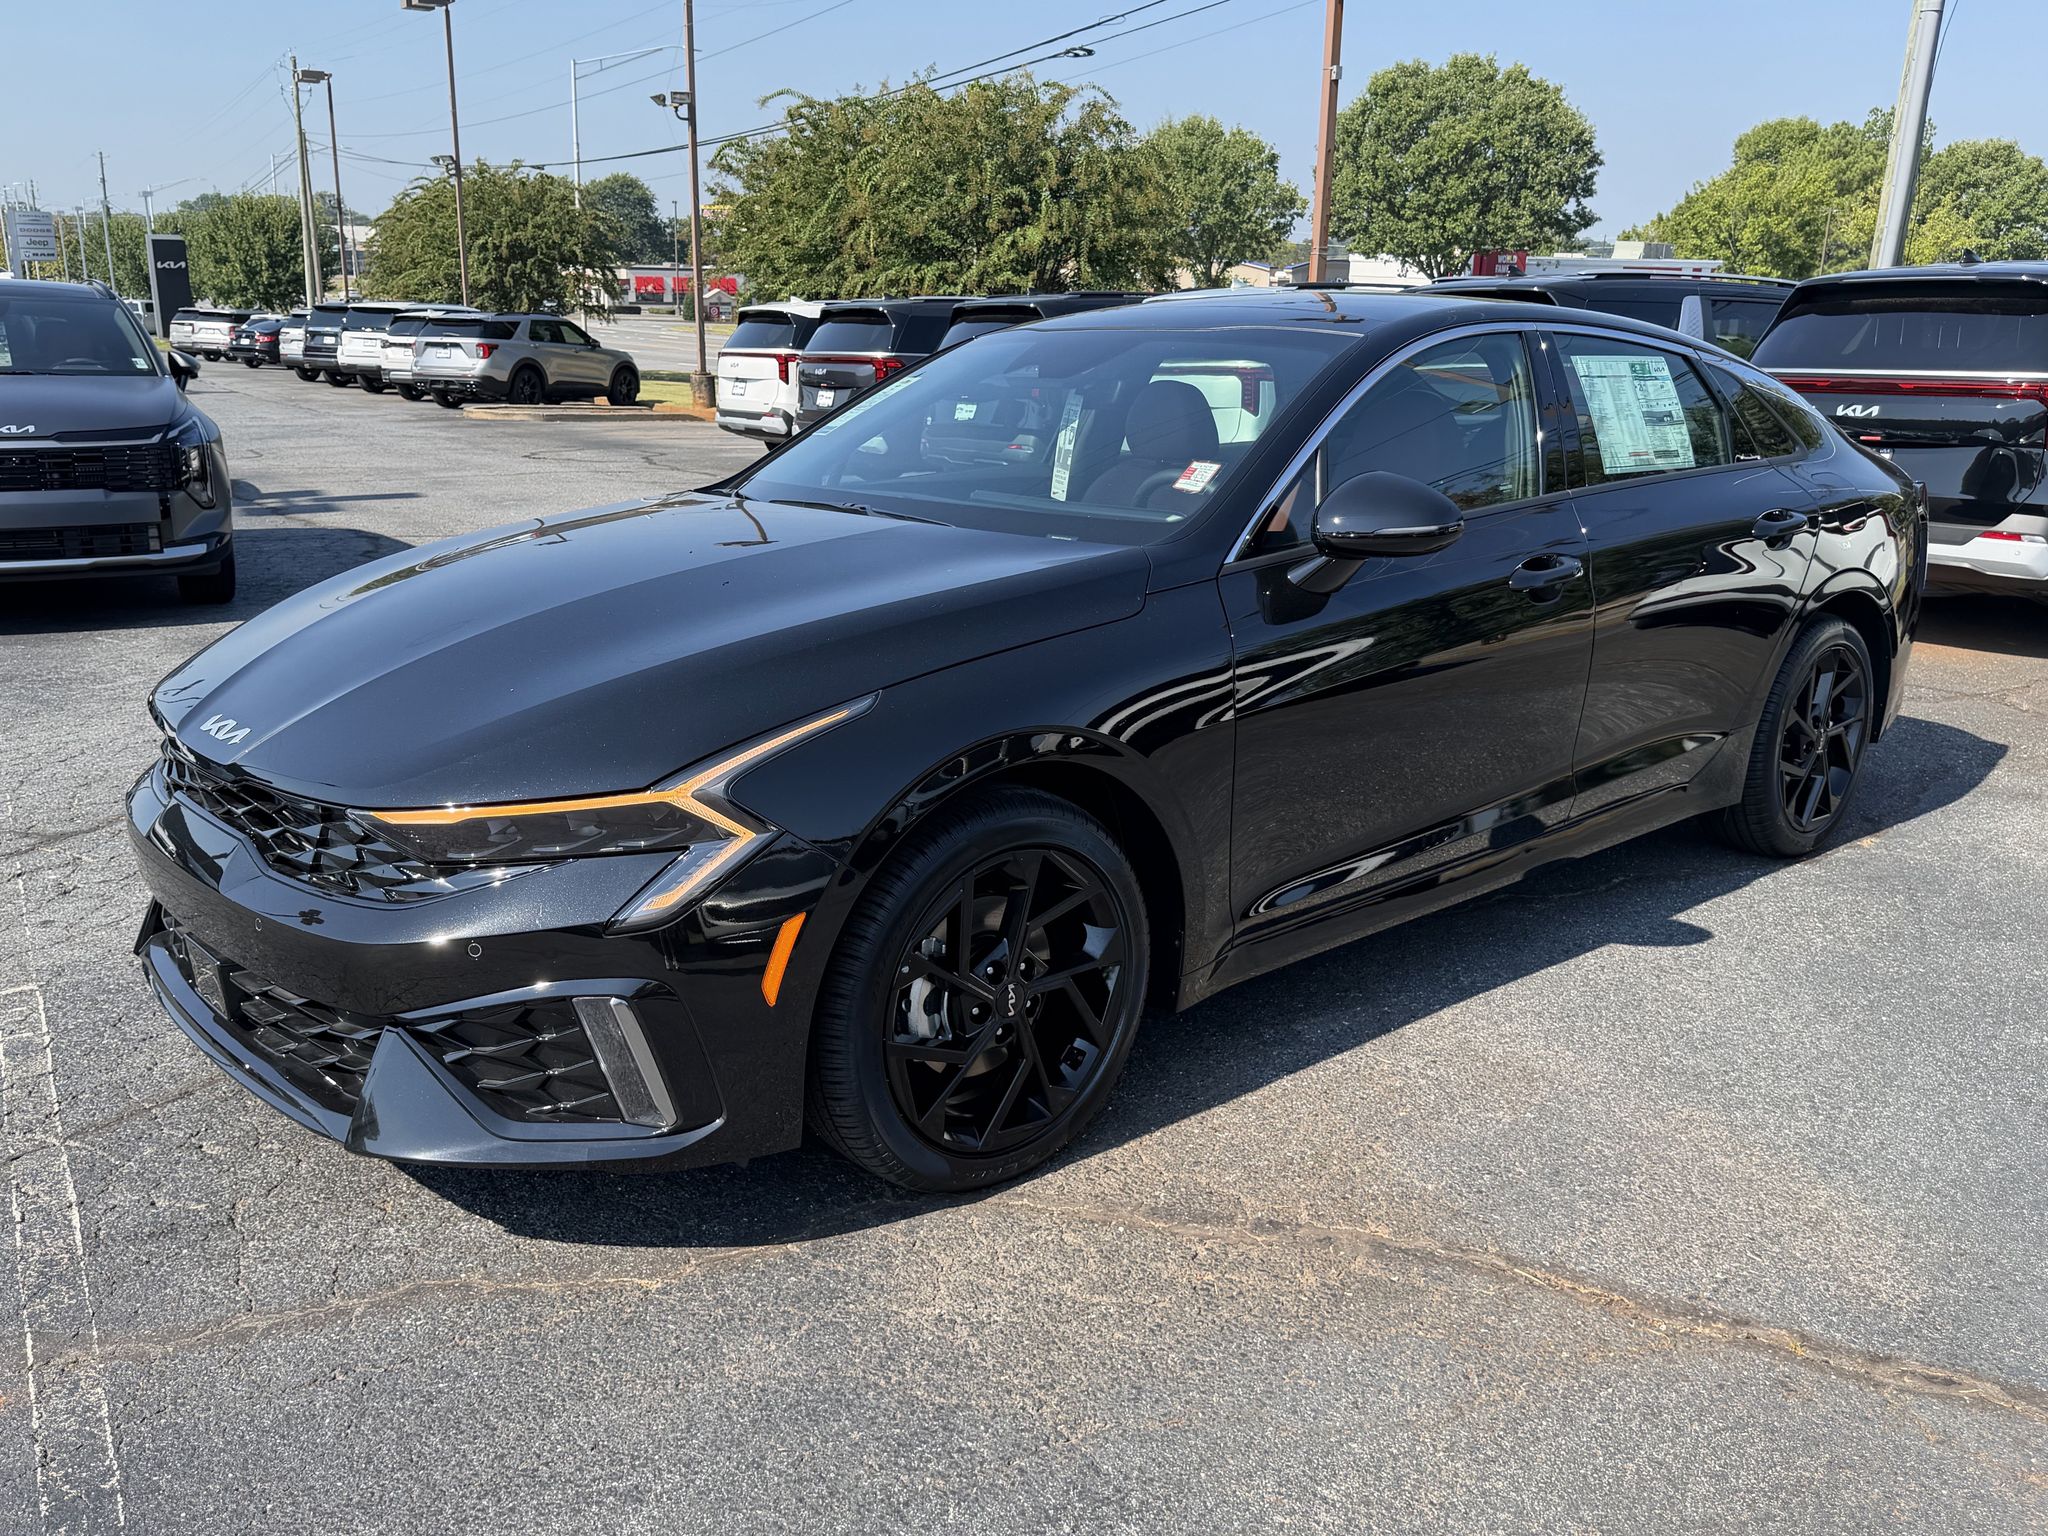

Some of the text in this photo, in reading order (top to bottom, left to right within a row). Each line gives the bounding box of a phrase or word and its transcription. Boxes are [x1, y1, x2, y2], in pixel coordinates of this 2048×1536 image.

[26, 238, 49, 247] Jeep
[156, 260, 186, 269] KIA
[1497, 255, 1517, 263] WORLD
[1835, 404, 1880, 417] KIA
[199, 713, 252, 745] KIA
[1007, 983, 1016, 1017] KIA
